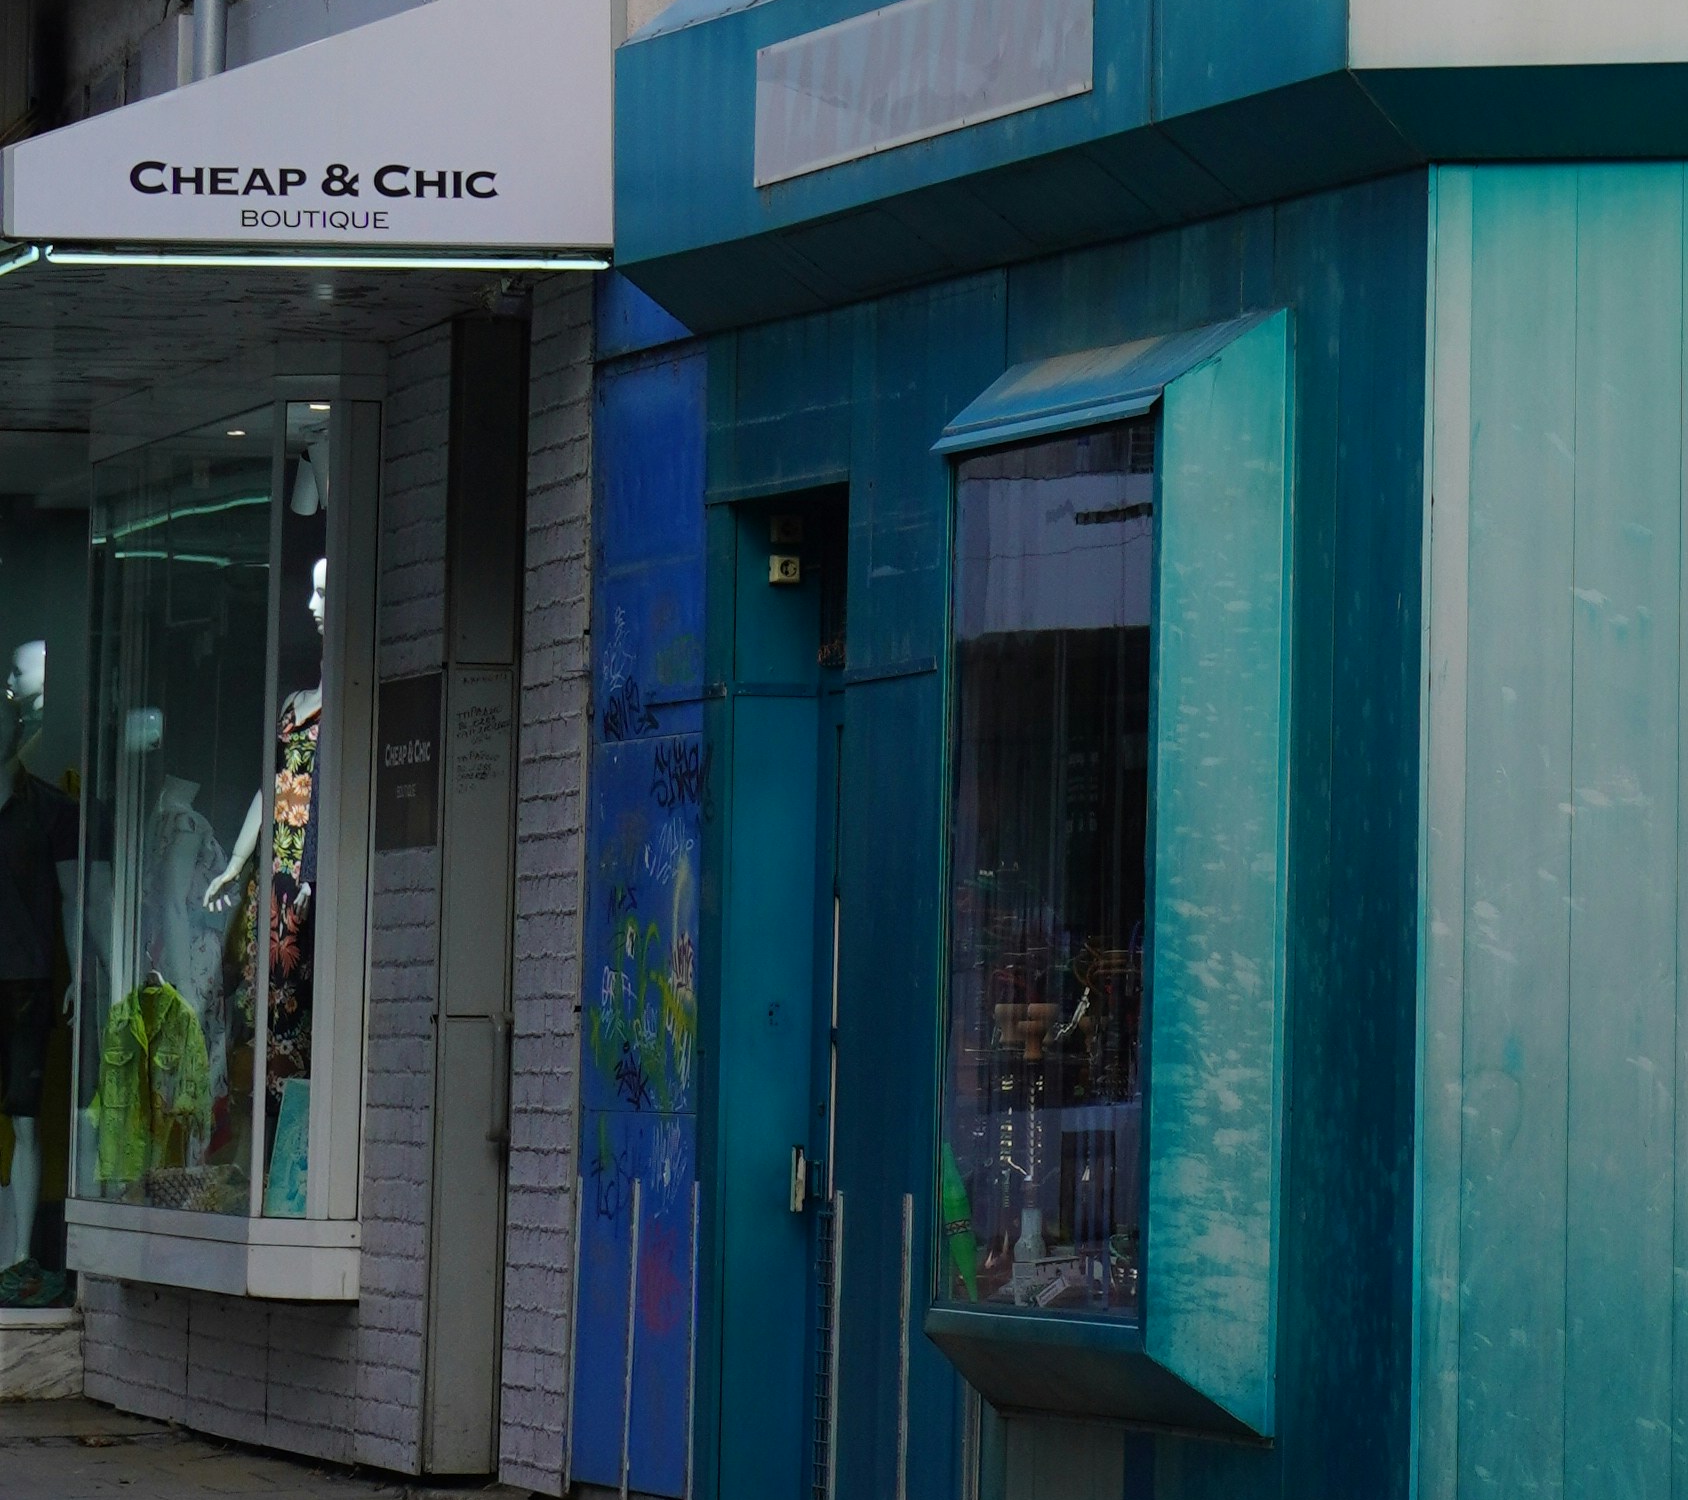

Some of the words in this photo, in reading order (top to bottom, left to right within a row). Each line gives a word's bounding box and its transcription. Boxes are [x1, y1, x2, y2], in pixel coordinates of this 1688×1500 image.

[129, 160, 307, 197] CHEAP
[321, 163, 360, 198] &
[373, 164, 500, 199] CHIC
[240, 208, 390, 230] BOUTIQUE
